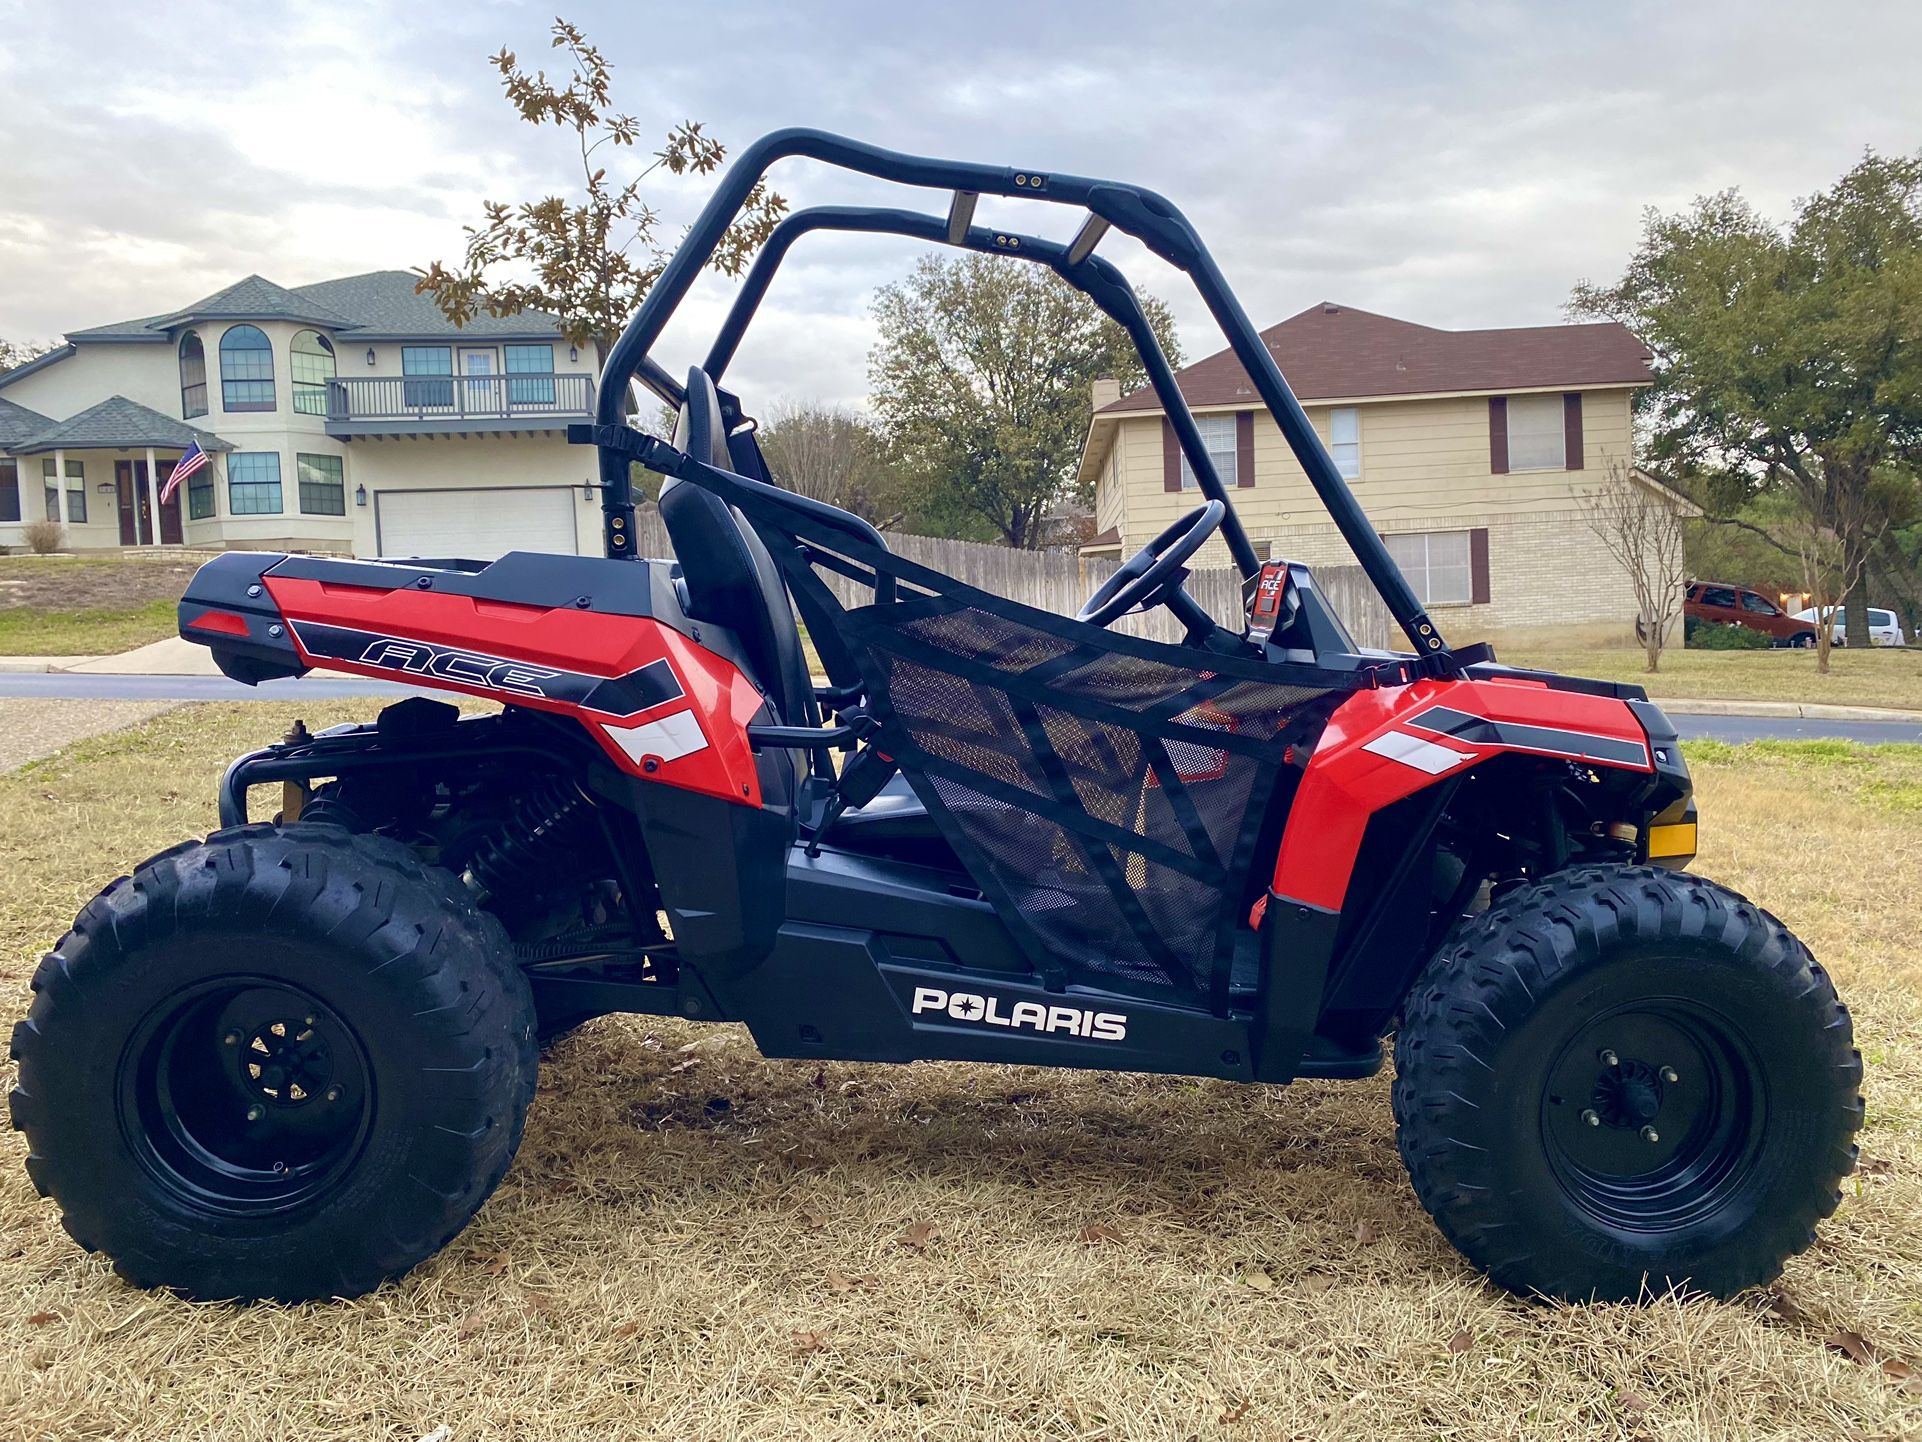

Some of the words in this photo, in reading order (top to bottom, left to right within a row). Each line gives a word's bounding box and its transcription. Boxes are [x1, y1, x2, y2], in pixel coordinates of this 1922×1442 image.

[1260, 579, 1281, 591] ACE
[359, 639, 562, 697] ACE
[911, 987, 1127, 1041] POLARIS
